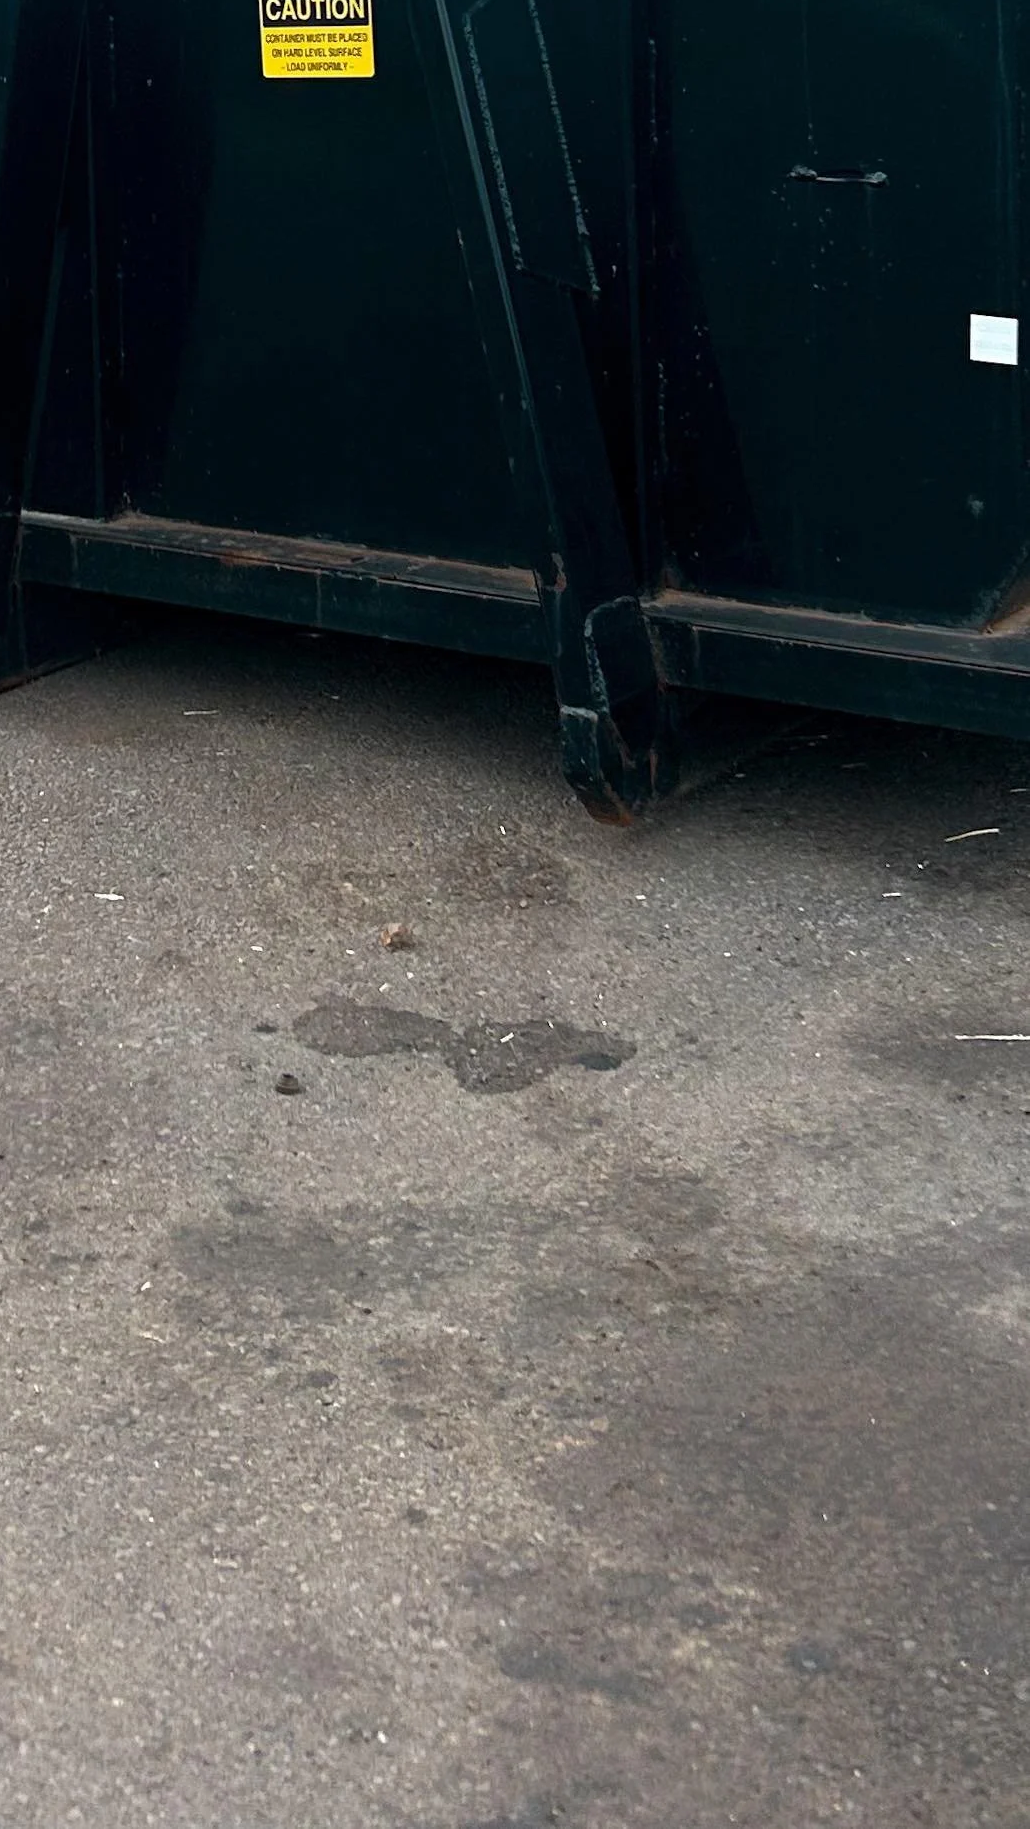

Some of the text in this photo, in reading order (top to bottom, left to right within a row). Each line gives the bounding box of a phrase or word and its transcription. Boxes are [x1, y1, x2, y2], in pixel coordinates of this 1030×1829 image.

[265, 33, 368, 44] CONTAINER MUST BE PLACED
[271, 47, 363, 58] ON HARD LEVEL SURFACE
[286, 62, 348, 71] LOAD UNIFORMLY
